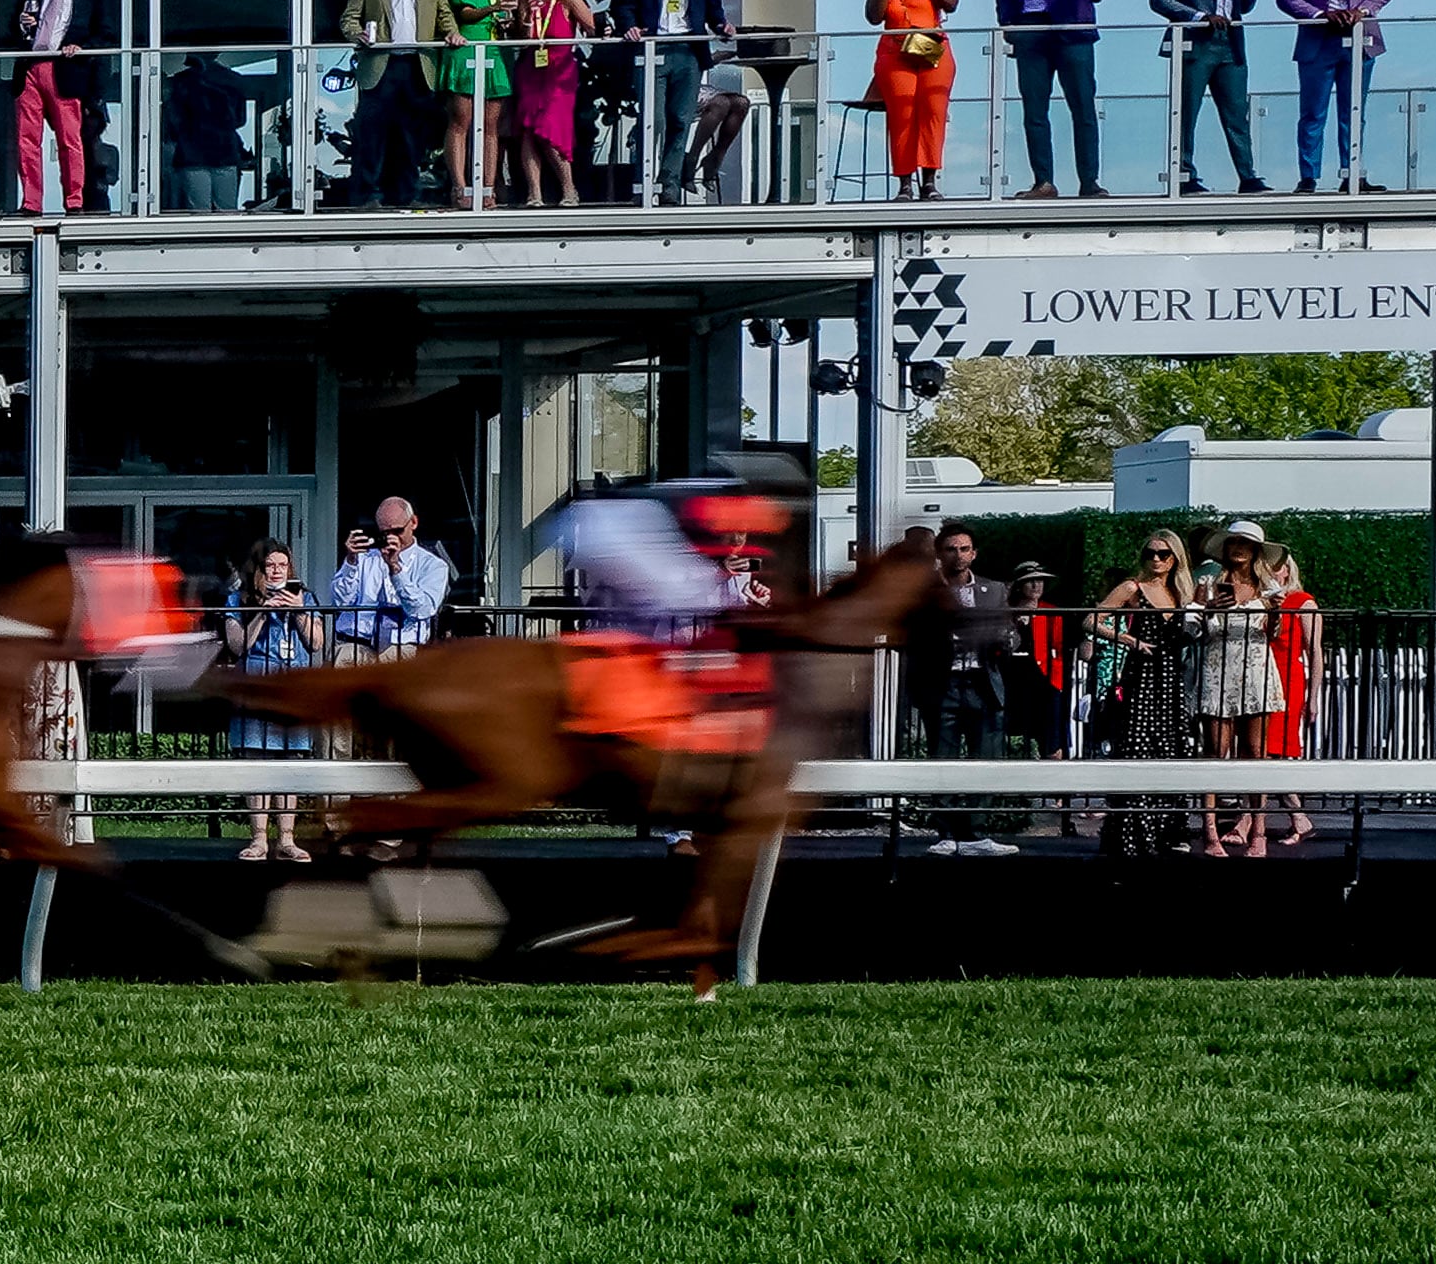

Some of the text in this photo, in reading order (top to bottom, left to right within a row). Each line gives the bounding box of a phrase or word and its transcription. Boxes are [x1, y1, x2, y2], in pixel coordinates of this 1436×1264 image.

[1021, 284, 1436, 322] LOWER LEVEL EN
